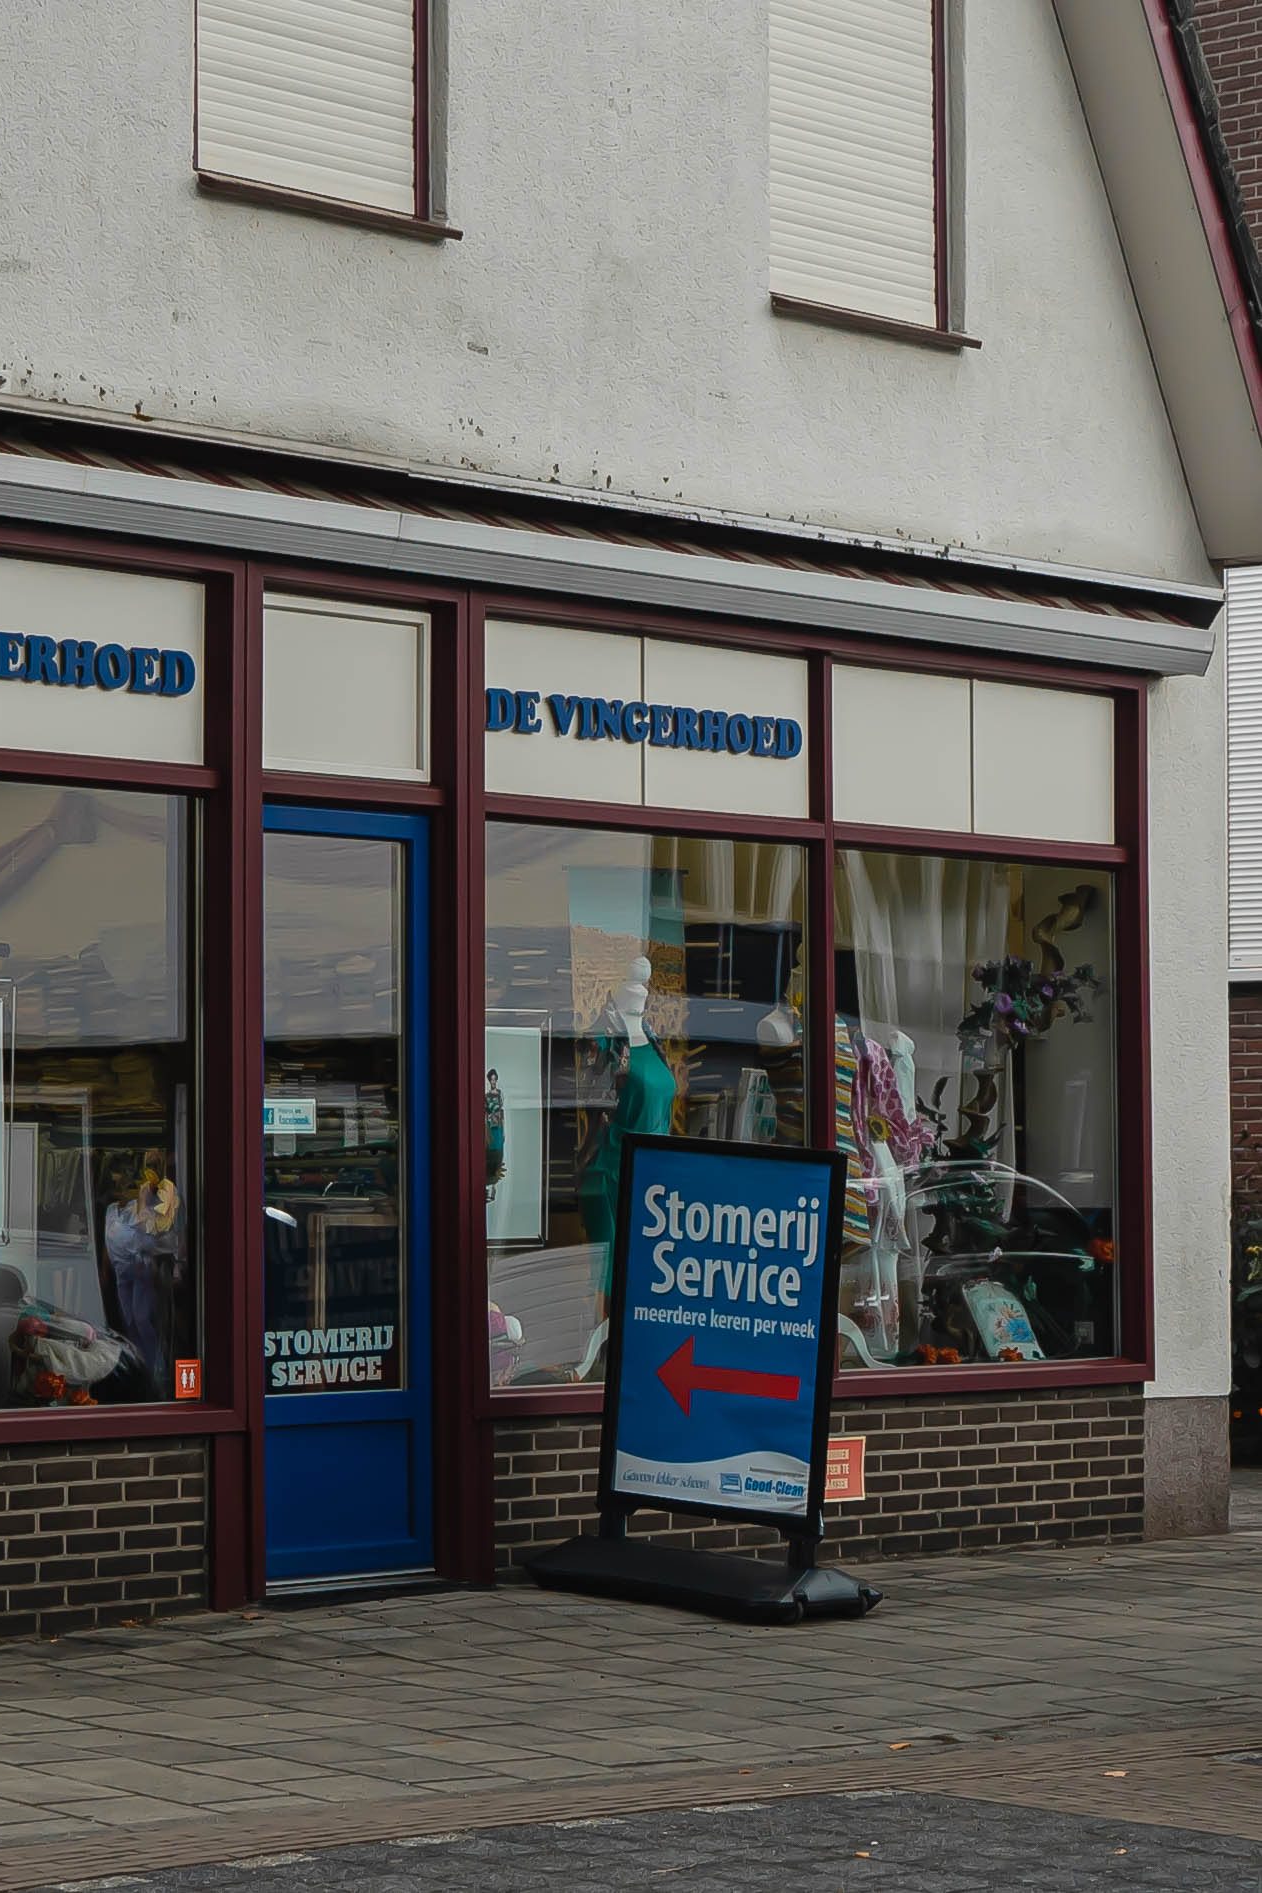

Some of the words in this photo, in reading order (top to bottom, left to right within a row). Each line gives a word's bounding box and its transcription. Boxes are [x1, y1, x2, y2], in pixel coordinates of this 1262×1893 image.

[485, 688, 542, 733] DE
[546, 693, 804, 760] VINGERHOED
[642, 1184, 820, 1267] Stomerij
[650, 1240, 801, 1307] Service
[634, 1305, 707, 1327] meerdere
[710, 1308, 751, 1332] keren
[753, 1318, 777, 1338] per
[780, 1319, 816, 1339] week
[264, 1325, 394, 1357] STOMERIJ
[271, 1355, 382, 1387] SERVICE
[745, 1477, 805, 1497] Good-Clean
